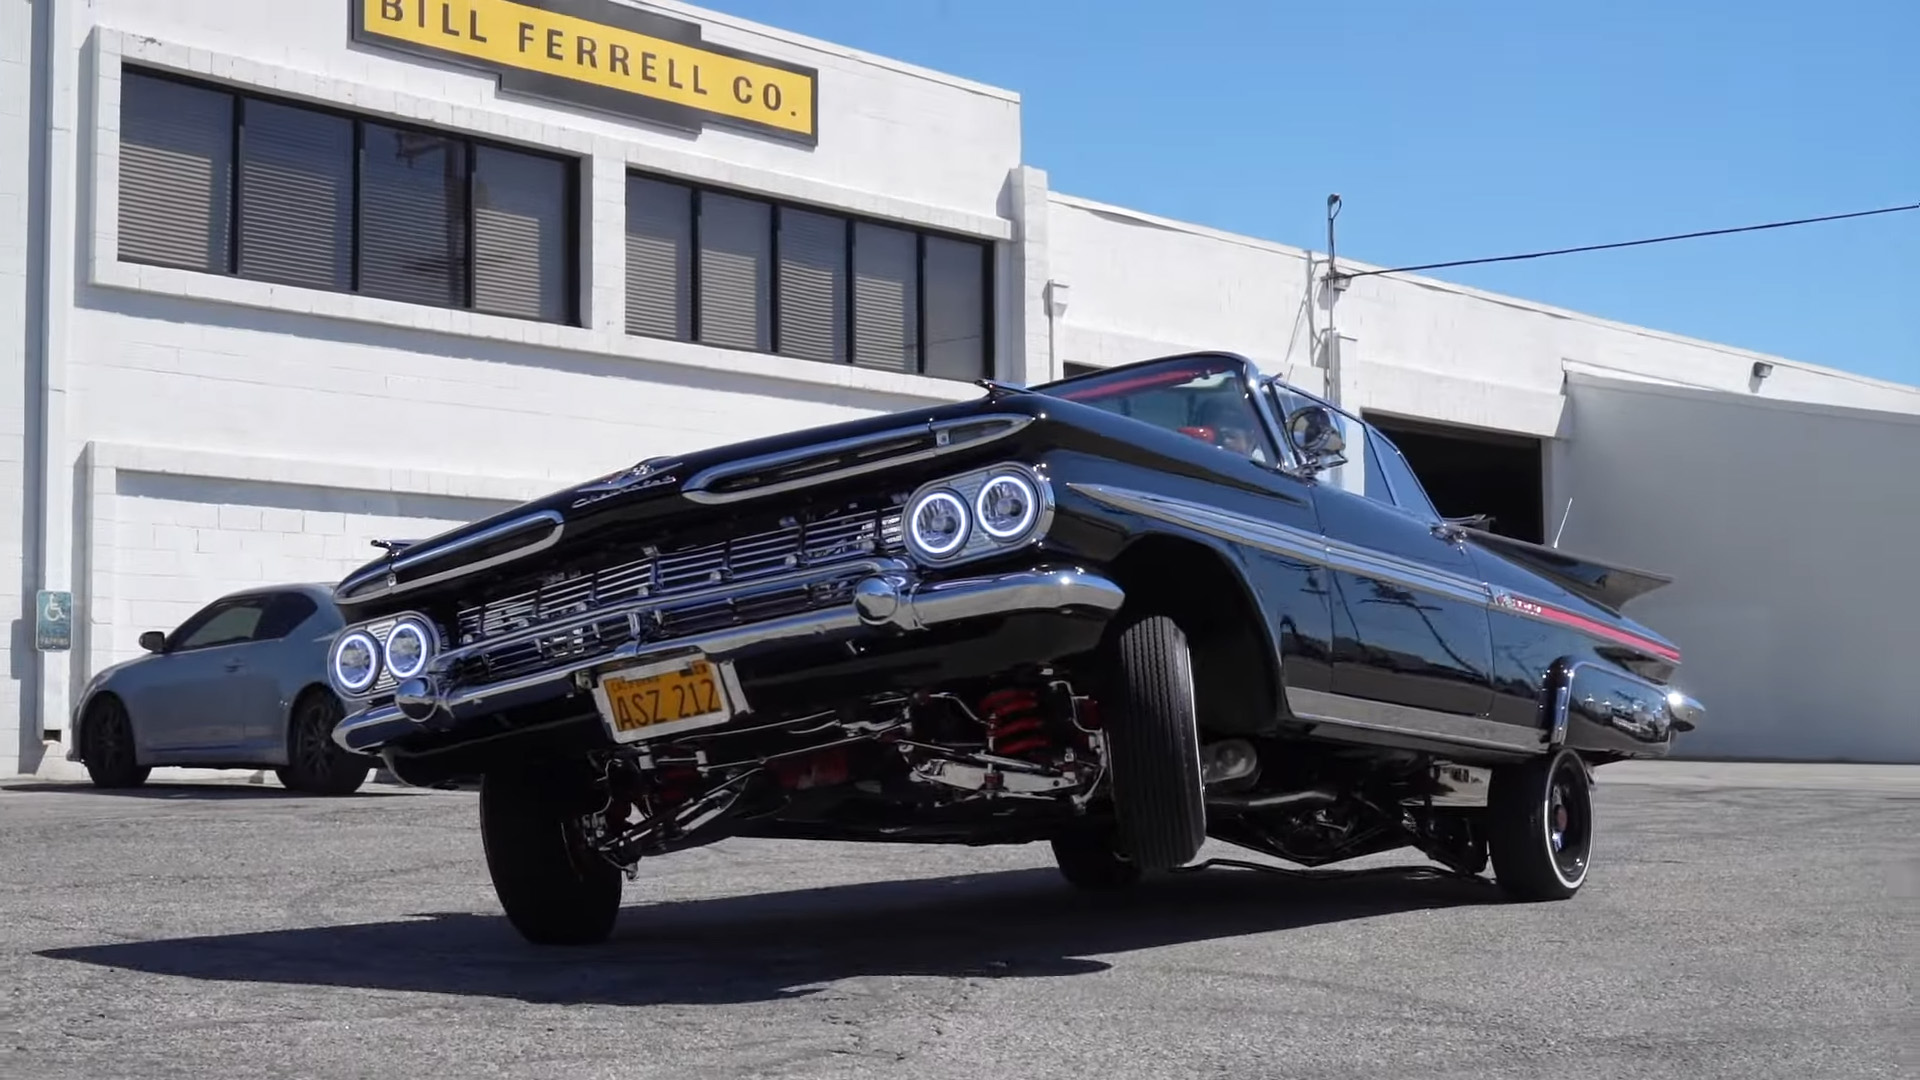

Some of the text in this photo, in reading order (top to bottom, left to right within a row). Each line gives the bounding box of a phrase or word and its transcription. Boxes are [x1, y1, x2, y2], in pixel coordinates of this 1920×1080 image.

[381, 0, 797, 117] BILL FERRELL CO.
[616, 689, 667, 730] ASZ
[672, 679, 722, 718] 212
